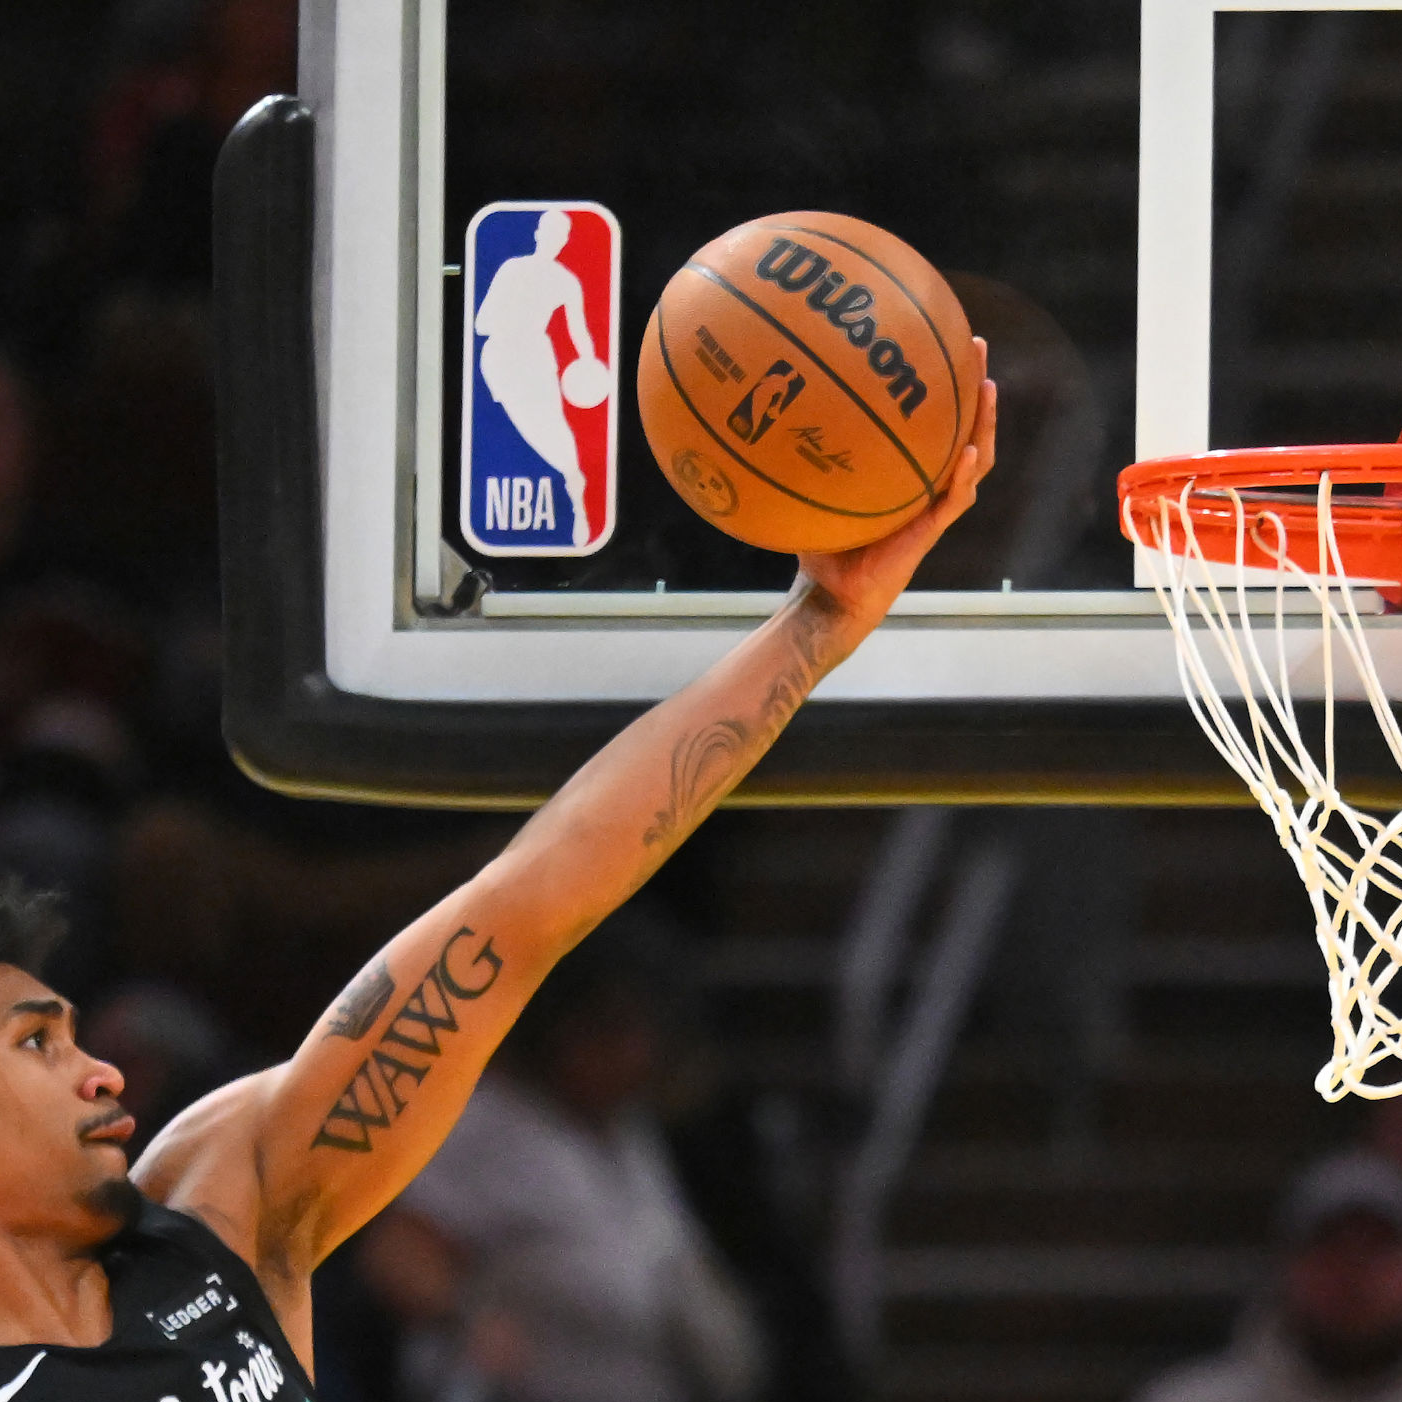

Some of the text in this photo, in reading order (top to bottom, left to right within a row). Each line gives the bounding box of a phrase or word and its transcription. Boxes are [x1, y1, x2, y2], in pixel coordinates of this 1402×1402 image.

[754, 236, 928, 421] Wilson
[485, 475, 556, 532] NBA
[310, 926, 504, 1154] WAWG
[158, 1288, 223, 1333] LEDGER
